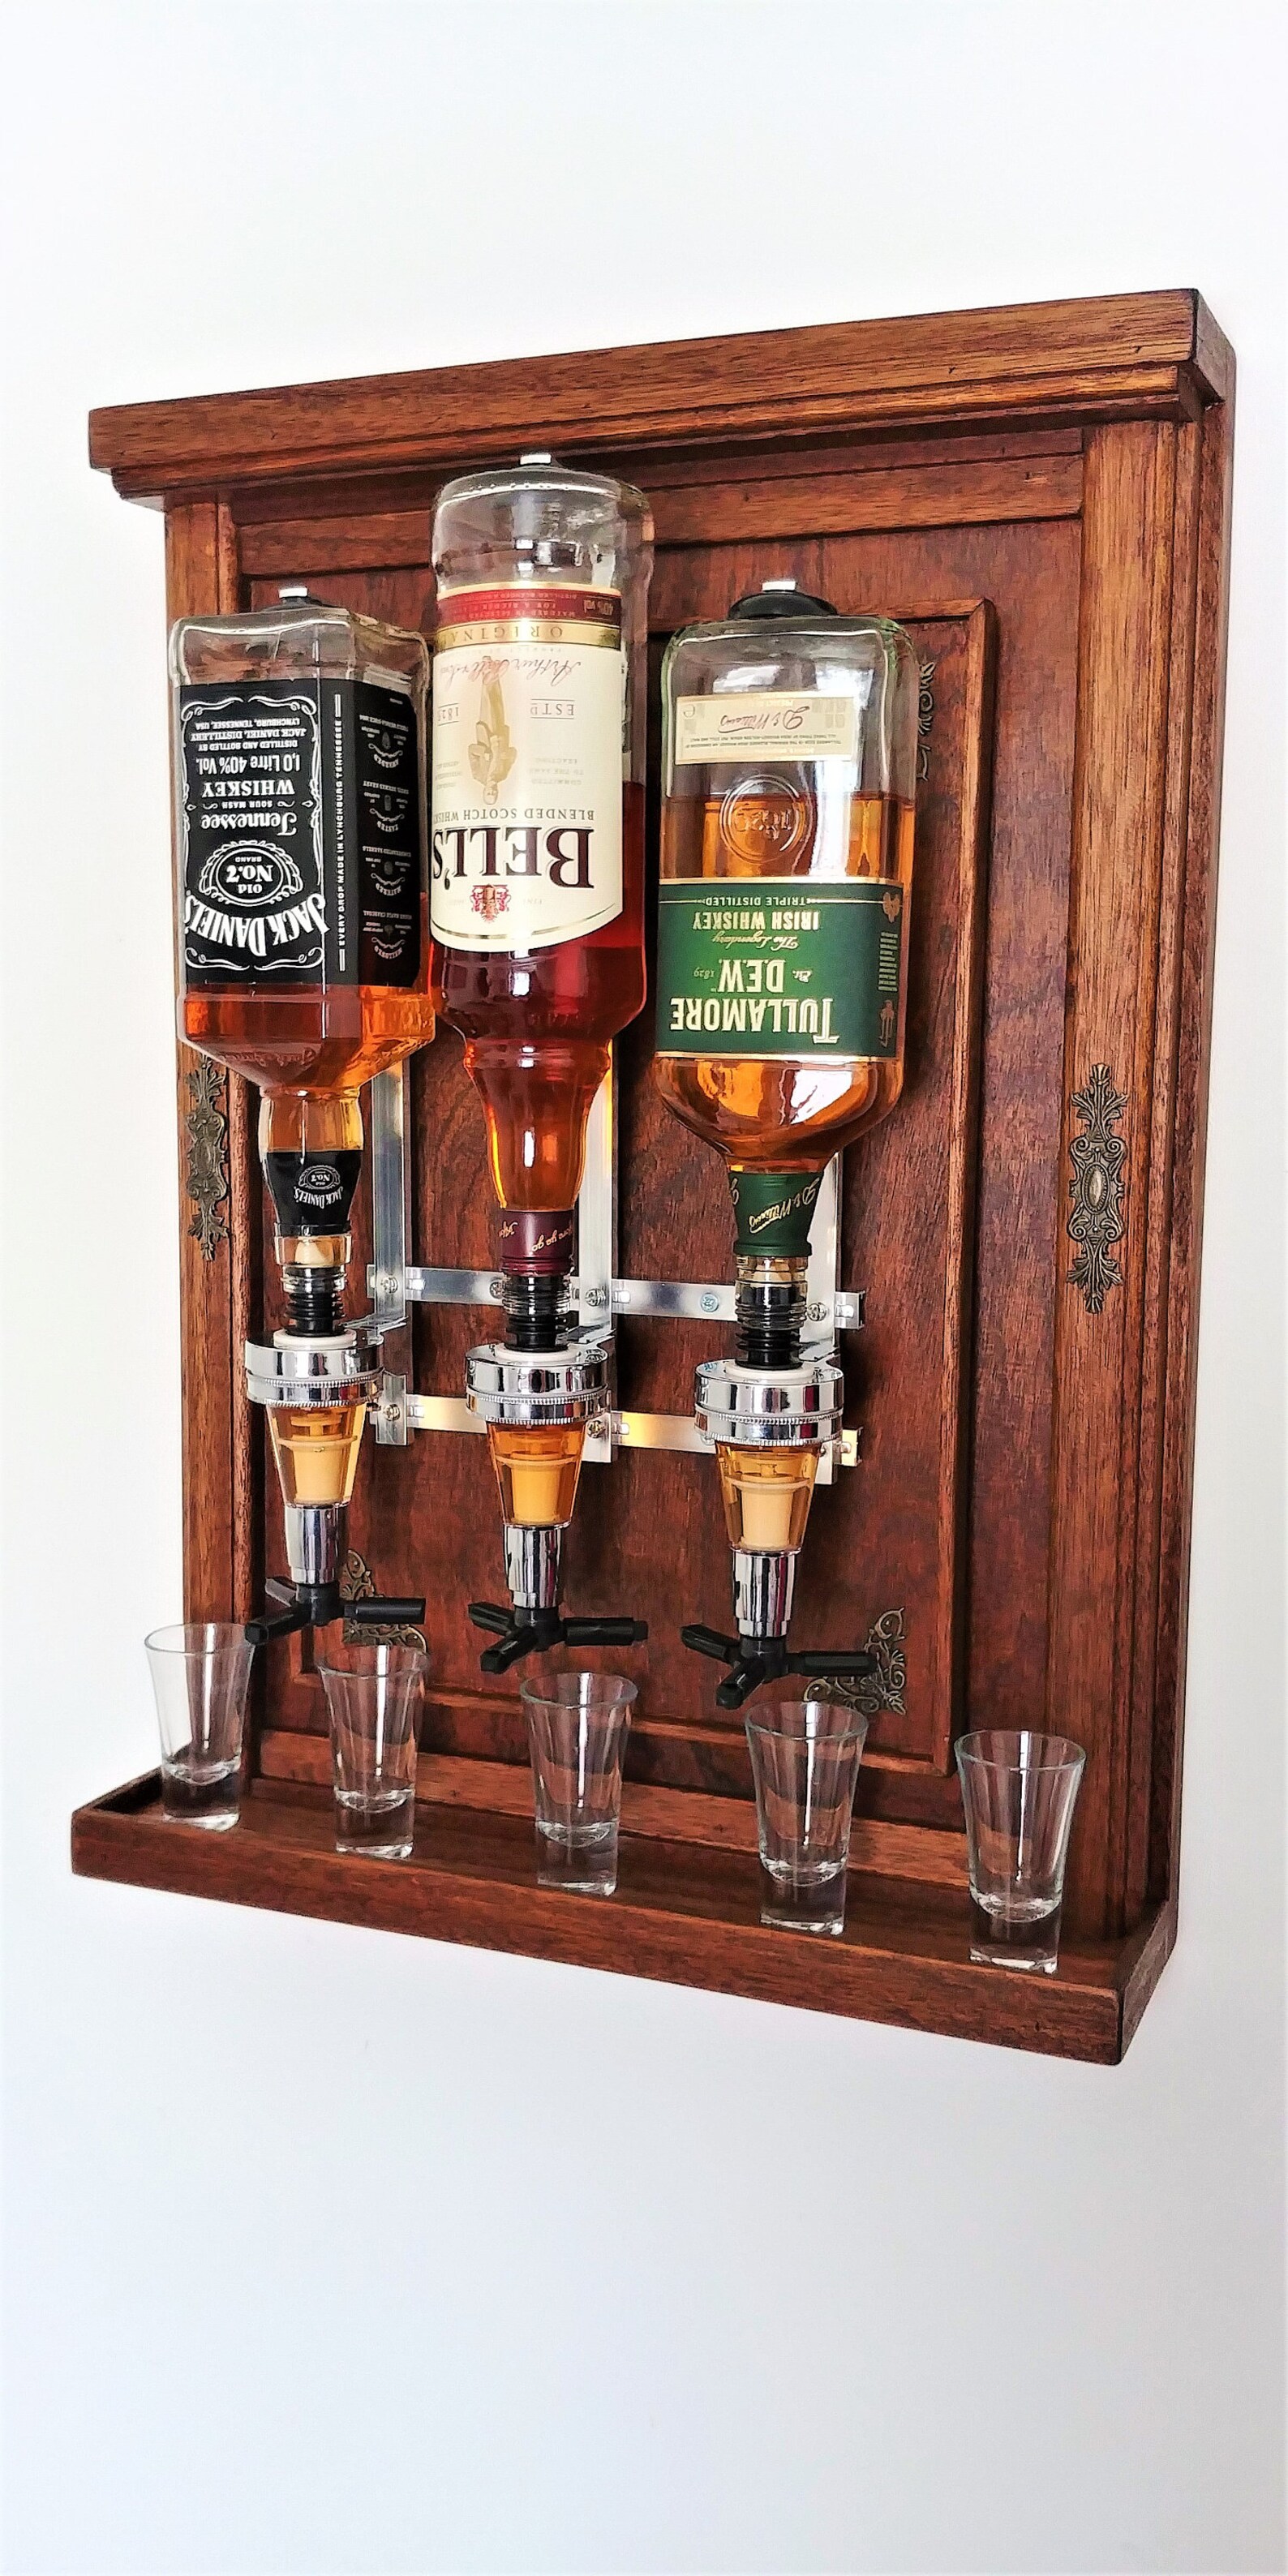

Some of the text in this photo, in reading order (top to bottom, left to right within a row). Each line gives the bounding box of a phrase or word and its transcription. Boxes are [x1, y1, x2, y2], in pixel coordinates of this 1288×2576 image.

[512, 659, 582, 687] Arthur
[195, 722, 209, 730] USA
[281, 728, 307, 737] JACK
[190, 731, 243, 741] DISTILLERY
[260, 740, 298, 749] DISTILLED
[209, 742, 241, 750] BOTTLED
[243, 741, 258, 749] AND
[195, 758, 217, 775] Vol.
[219, 757, 247, 774] 40%
[250, 754, 280, 771] Litre
[202, 779, 295, 798] WHISKEY
[221, 800, 273, 809] SOUR MASH
[462, 809, 517, 820] SCOTCH
[524, 808, 594, 821] BLENDED
[201, 812, 298, 836] Tennessee
[334, 720, 346, 946] EVERY DROP MADE IN LYNCHBURG TENNESSEE
[433, 826, 595, 891] BELL'S
[225, 865, 273, 882] No.7
[238, 883, 263, 894] Old
[706, 896, 806, 906] TRIPLE DISTILLED
[183, 893, 330, 956] JACK DANIEL'S
[692, 911, 820, 930] IRISH WHISKEY
[711, 931, 798, 951] The Legendary
[693, 967, 715, 978] 1829
[718, 959, 785, 993] D.E.W.
[670, 998, 839, 1045] TULLAMORE
[294, 1187, 343, 1209] JACK DANIEL'S
[531, 1234, 544, 1252] go
